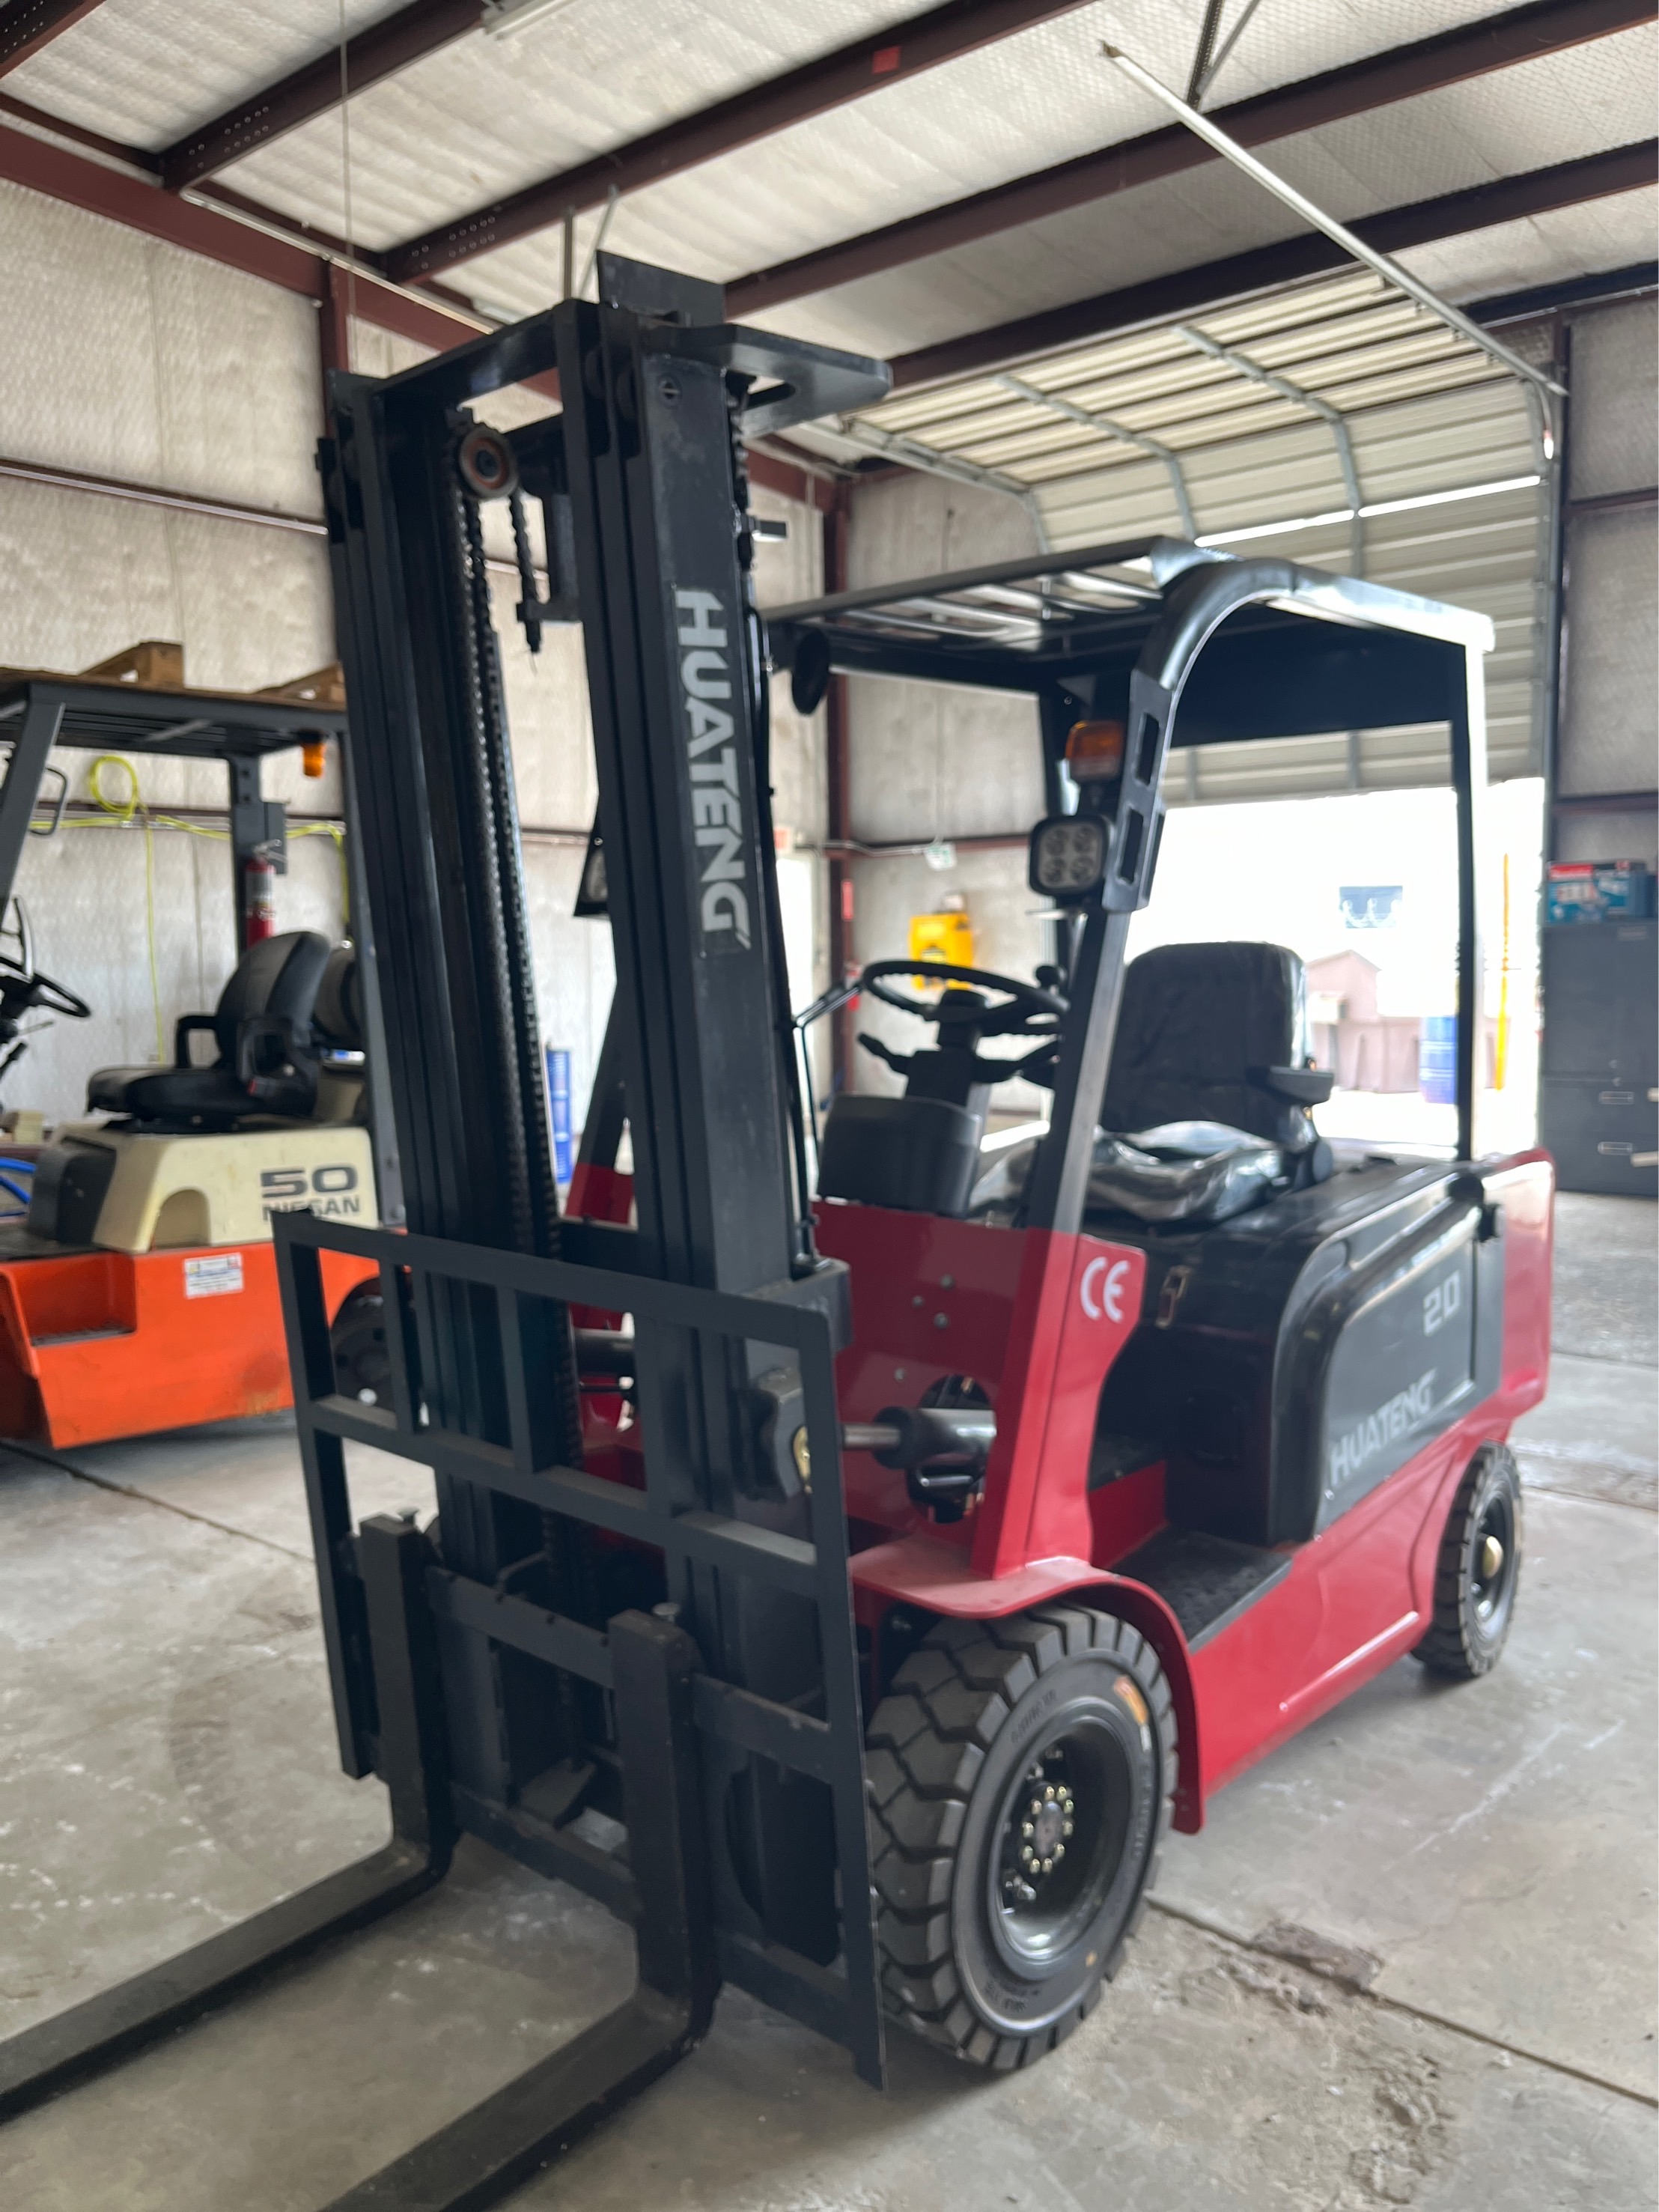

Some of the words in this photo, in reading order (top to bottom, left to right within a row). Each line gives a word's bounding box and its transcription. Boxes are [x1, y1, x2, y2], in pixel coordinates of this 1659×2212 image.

[675, 589, 752, 950] HUATENG
[261, 1164, 358, 1198] 50
[1080, 1256, 1130, 1323] CE
[1329, 1367, 1438, 1487] HUATENG
